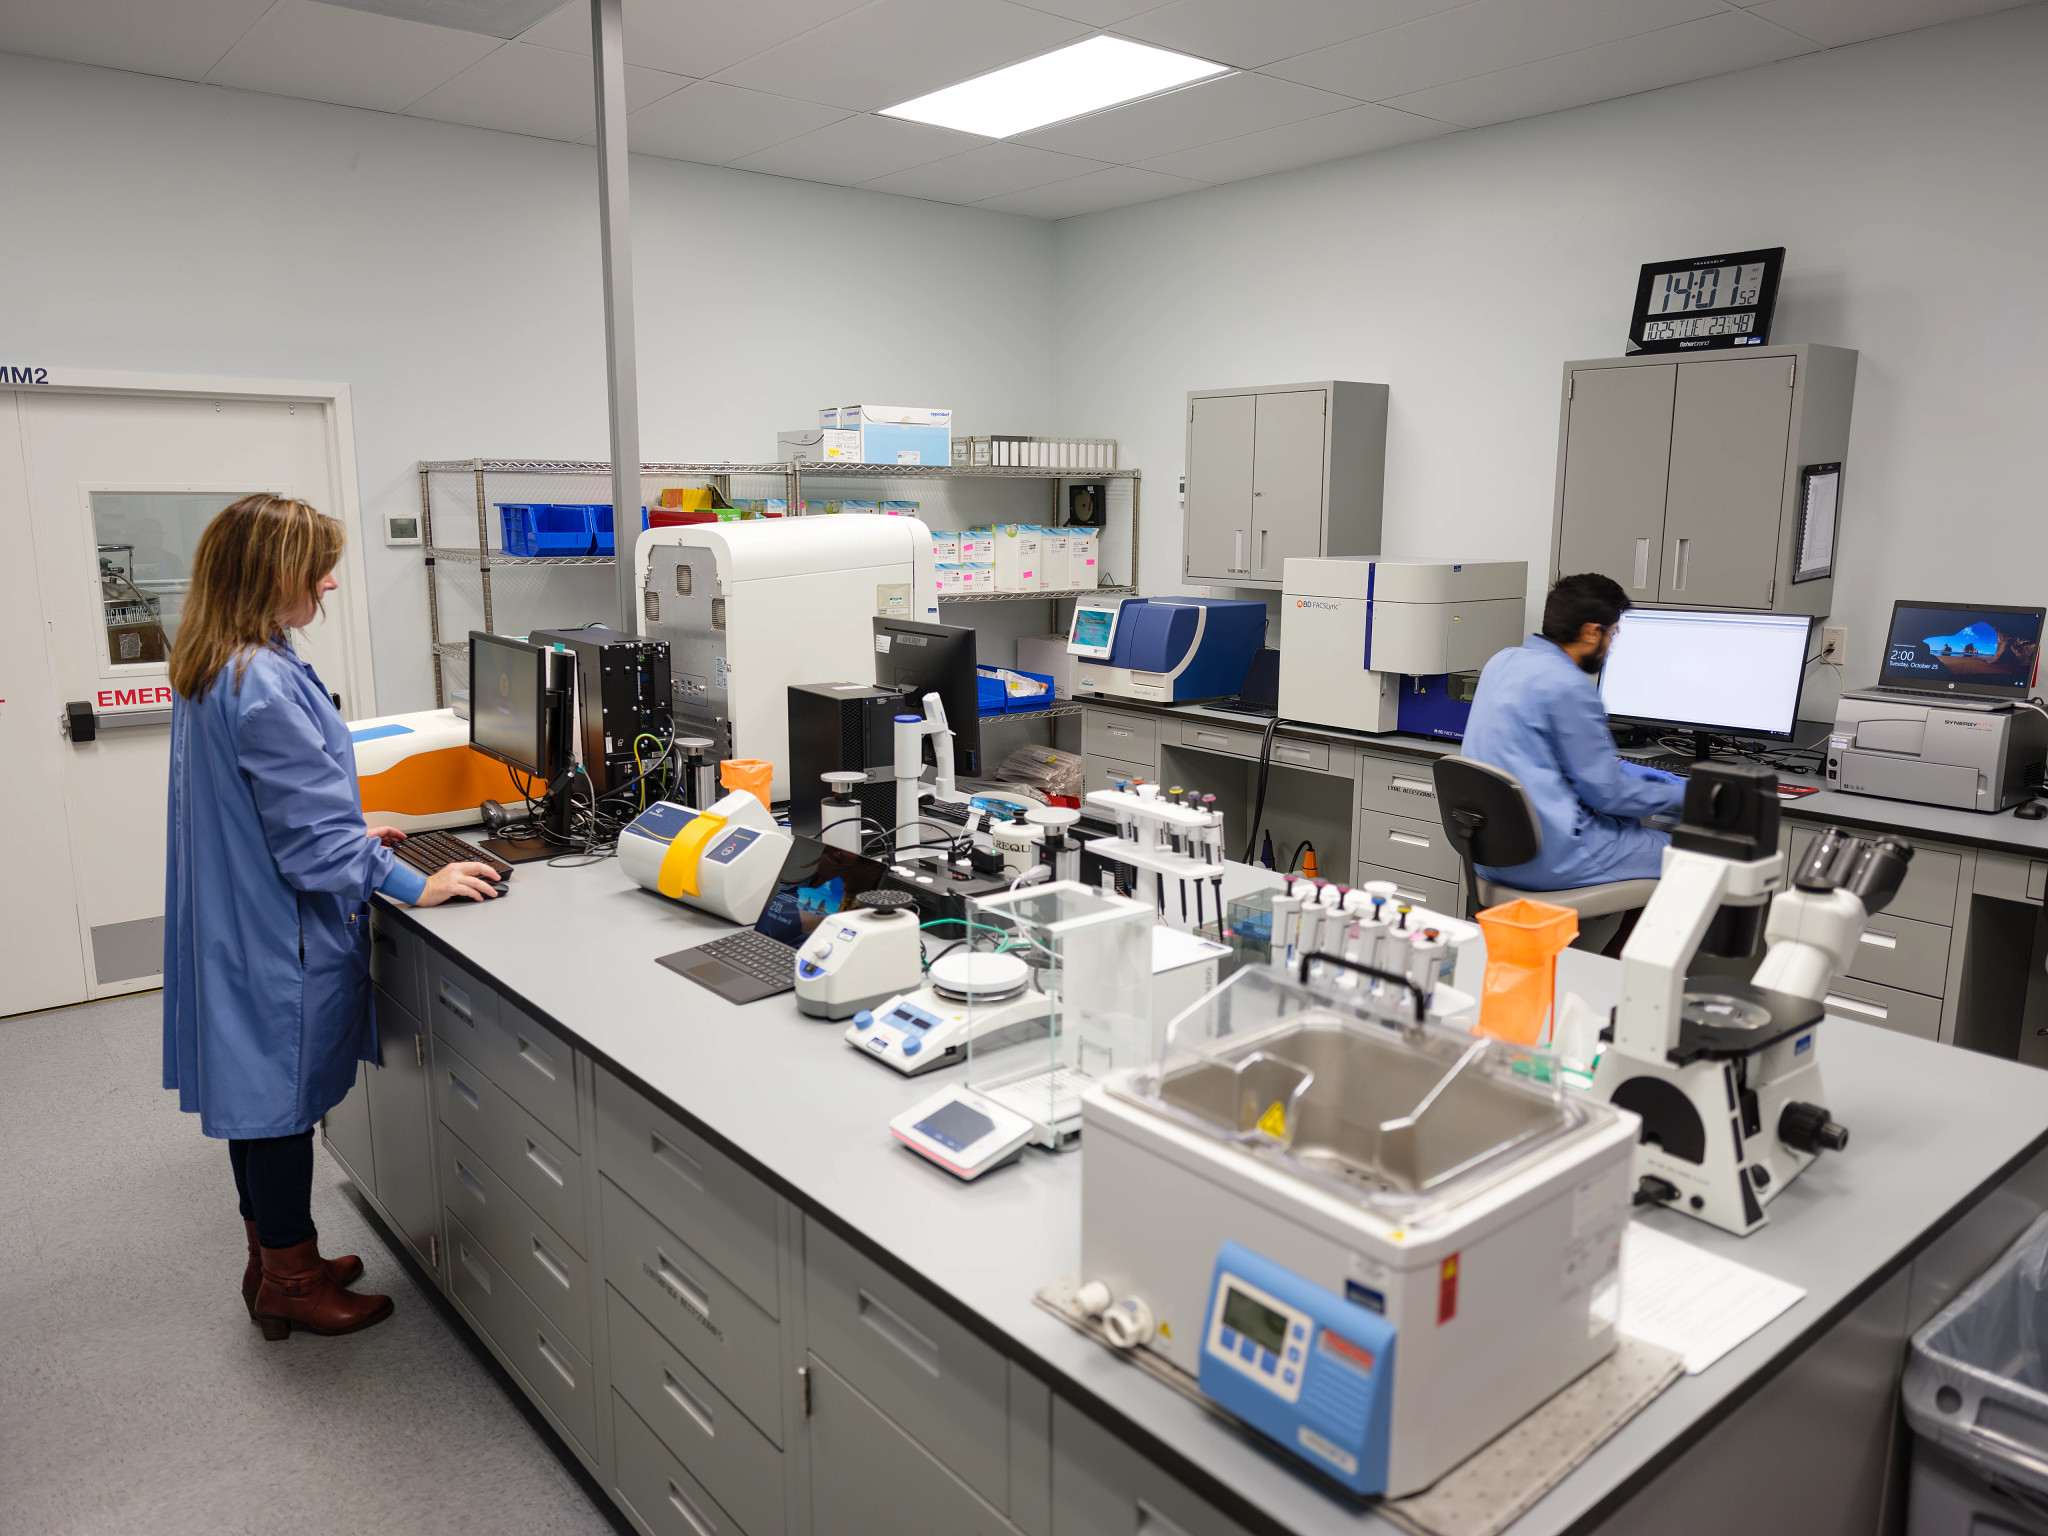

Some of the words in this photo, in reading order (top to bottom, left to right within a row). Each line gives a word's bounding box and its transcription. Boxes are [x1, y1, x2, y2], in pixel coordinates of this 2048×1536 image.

[1661, 265, 1742, 312] 14:01
[1738, 289, 1756, 305] 52
[1679, 318, 1702, 338] TUE
[1679, 340, 1710, 348] fisherbrand
[1303, 600, 1312, 608] BD
[1890, 649, 1915, 662] 2:00
[97, 686, 172, 708] EMER
[1944, 719, 1977, 727] SYNERGY
[1387, 785, 1402, 793] LYRIC
[1402, 787, 1436, 799] ACCESSORIES
